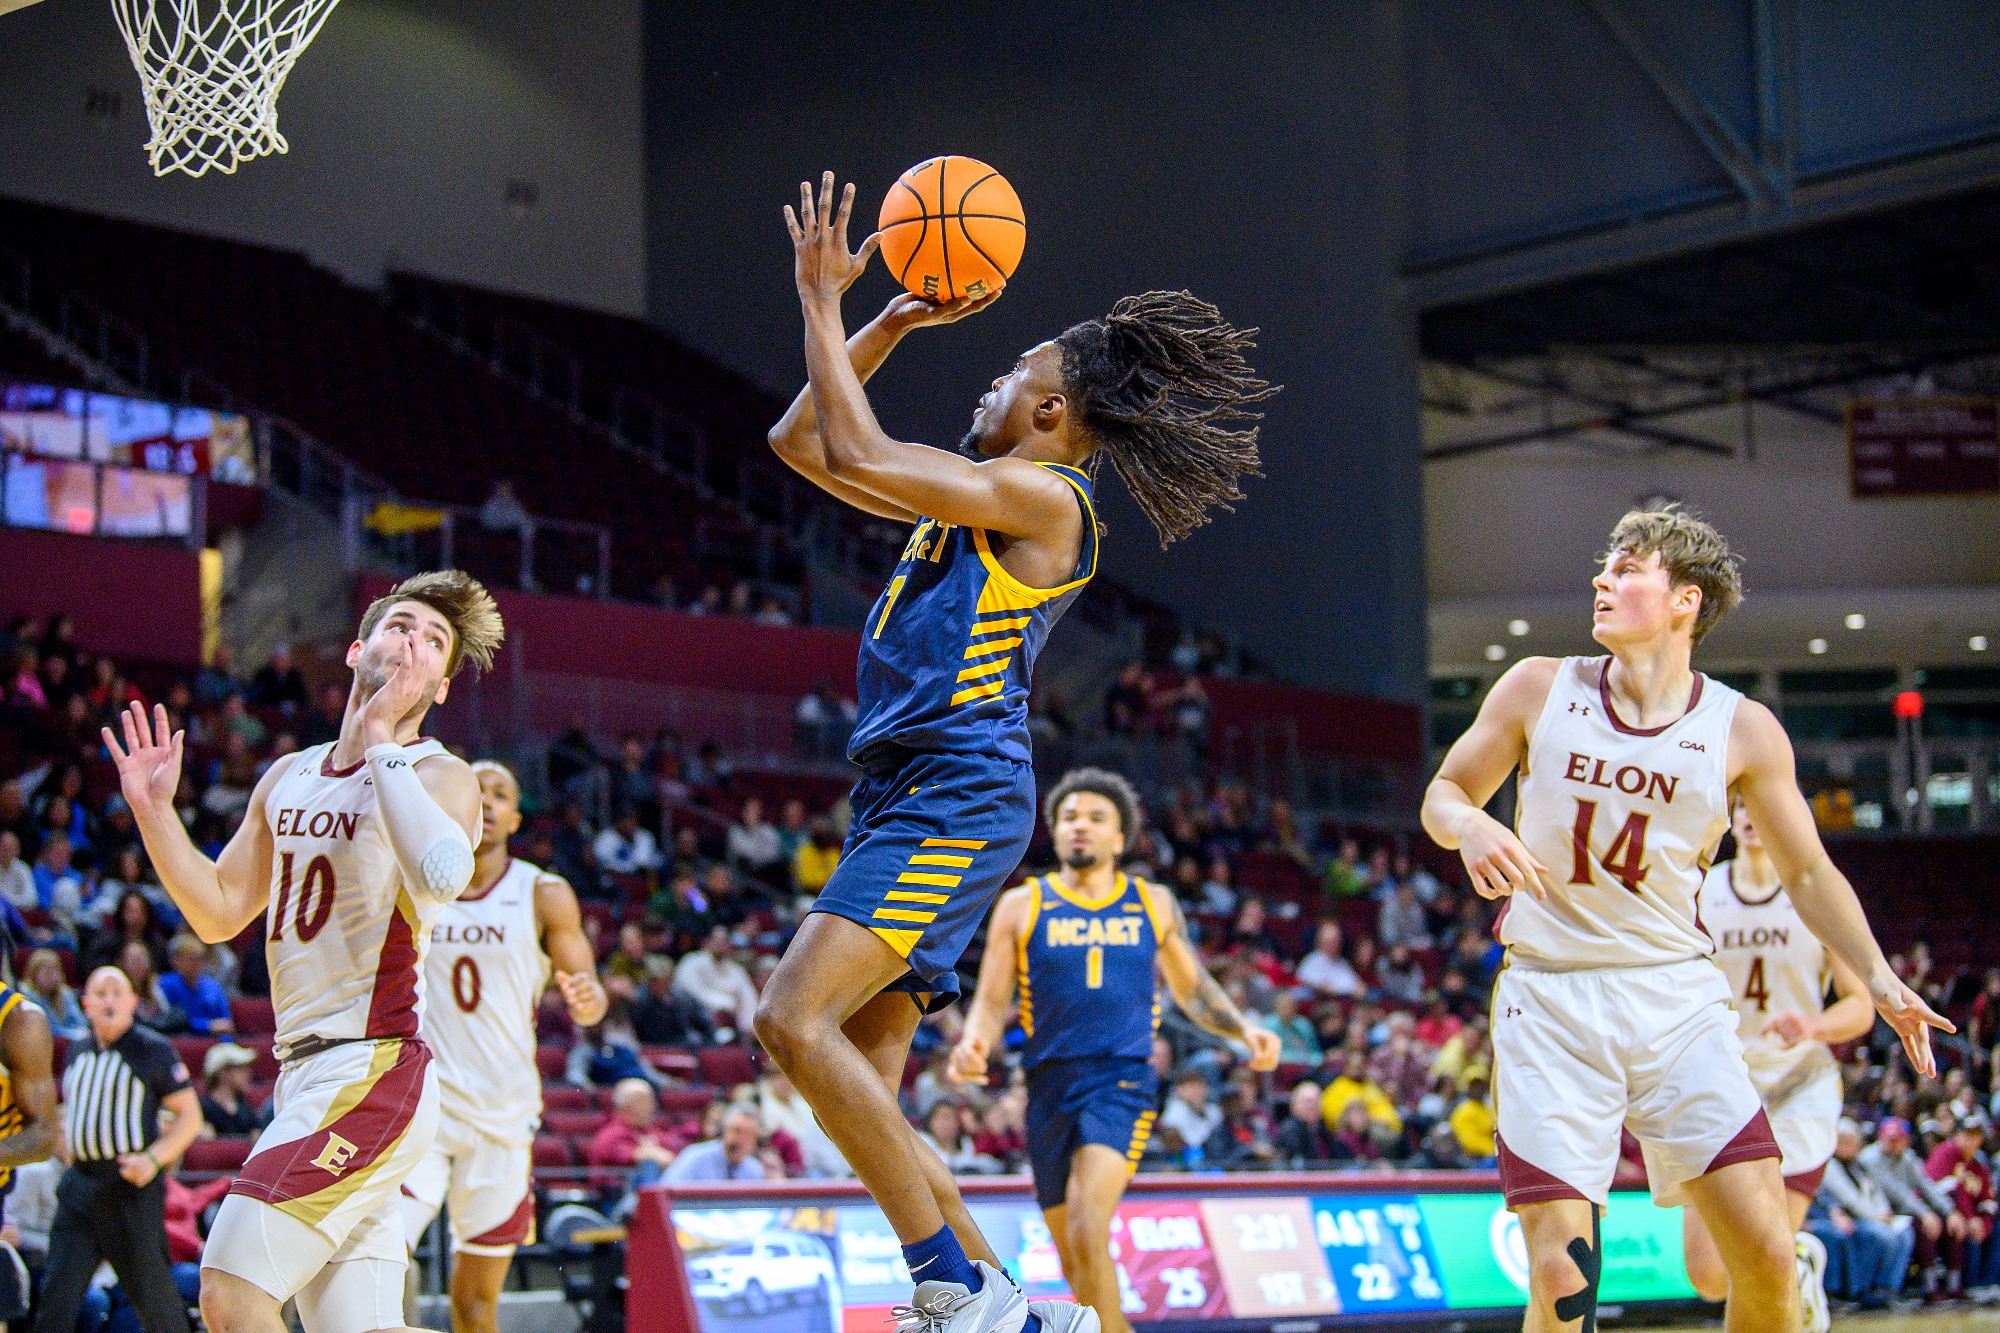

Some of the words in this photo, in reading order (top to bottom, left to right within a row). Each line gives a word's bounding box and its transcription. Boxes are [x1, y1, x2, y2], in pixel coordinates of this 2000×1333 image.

[1679, 741, 1705, 752] CAA
[1563, 752, 1680, 804] ELON
[276, 808, 361, 841] ELON
[1567, 796, 1651, 894] 14
[268, 850, 337, 944] 10
[431, 925, 505, 944] ELON
[1046, 916, 1144, 947] NCA&T
[1723, 927, 1789, 950] ELON
[452, 955, 482, 1013] 0
[1085, 946, 1104, 989] 1
[1743, 956, 1770, 1014] 4
[310, 1131, 359, 1177] E
[1128, 1216, 1204, 1251] ELON
[1233, 1212, 1298, 1250] 2:31
[1316, 1209, 1380, 1247] A&T
[1158, 1267, 1207, 1308] 25
[1352, 1263, 1396, 1300] 22
